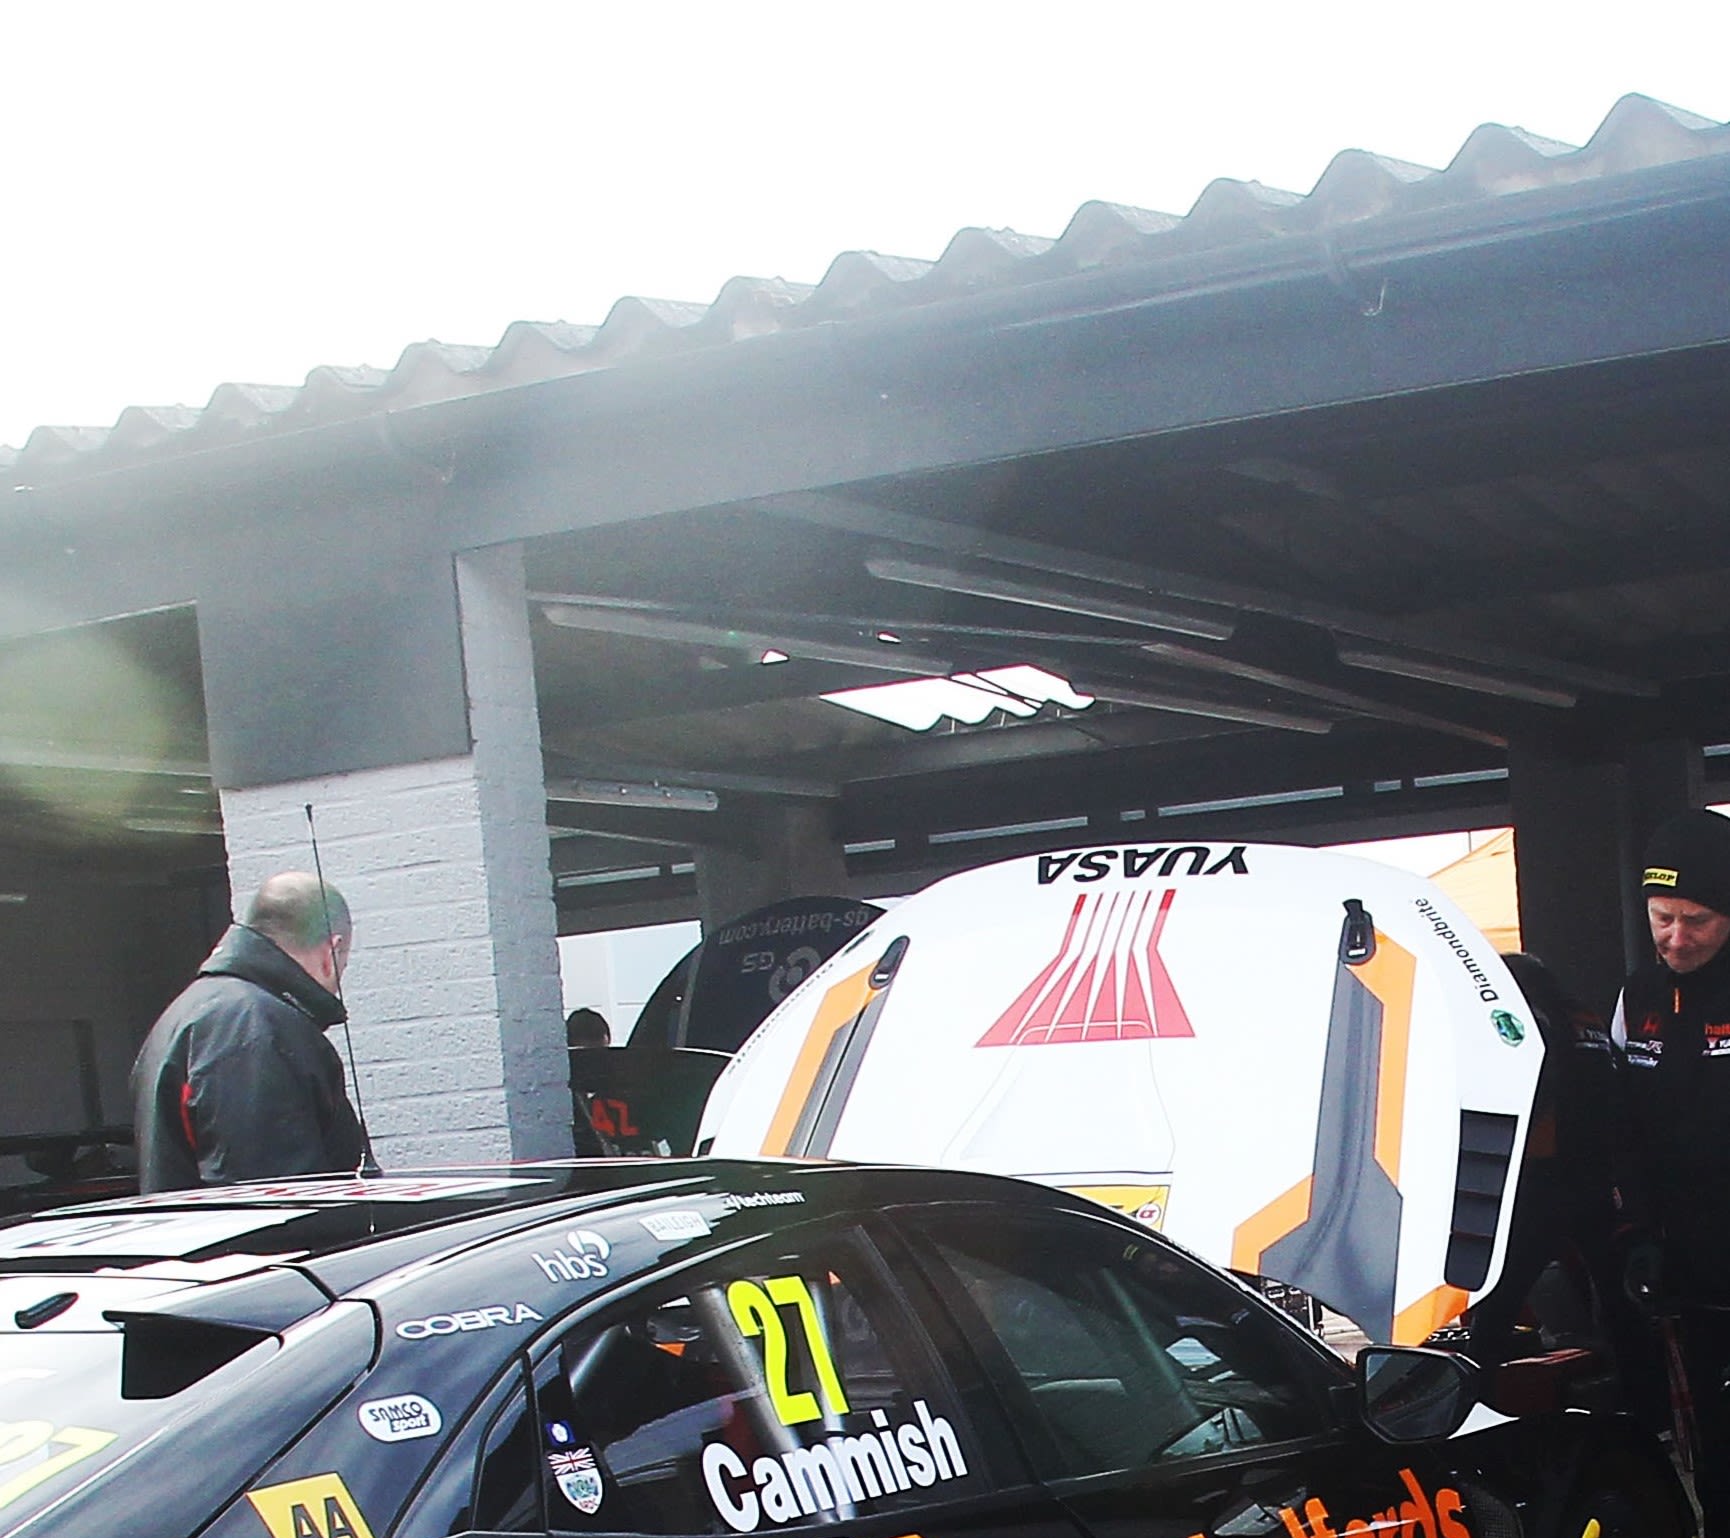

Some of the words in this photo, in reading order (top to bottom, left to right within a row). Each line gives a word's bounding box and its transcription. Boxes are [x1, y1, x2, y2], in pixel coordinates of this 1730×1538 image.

[1038, 846, 1250, 884] YUASA
[1415, 897, 1499, 1002] Diamondbrite
[532, 1250, 608, 1283] hbs
[396, 1303, 543, 1339] COBRA
[726, 1275, 851, 1426] 27
[702, 1400, 968, 1533] Cammish
